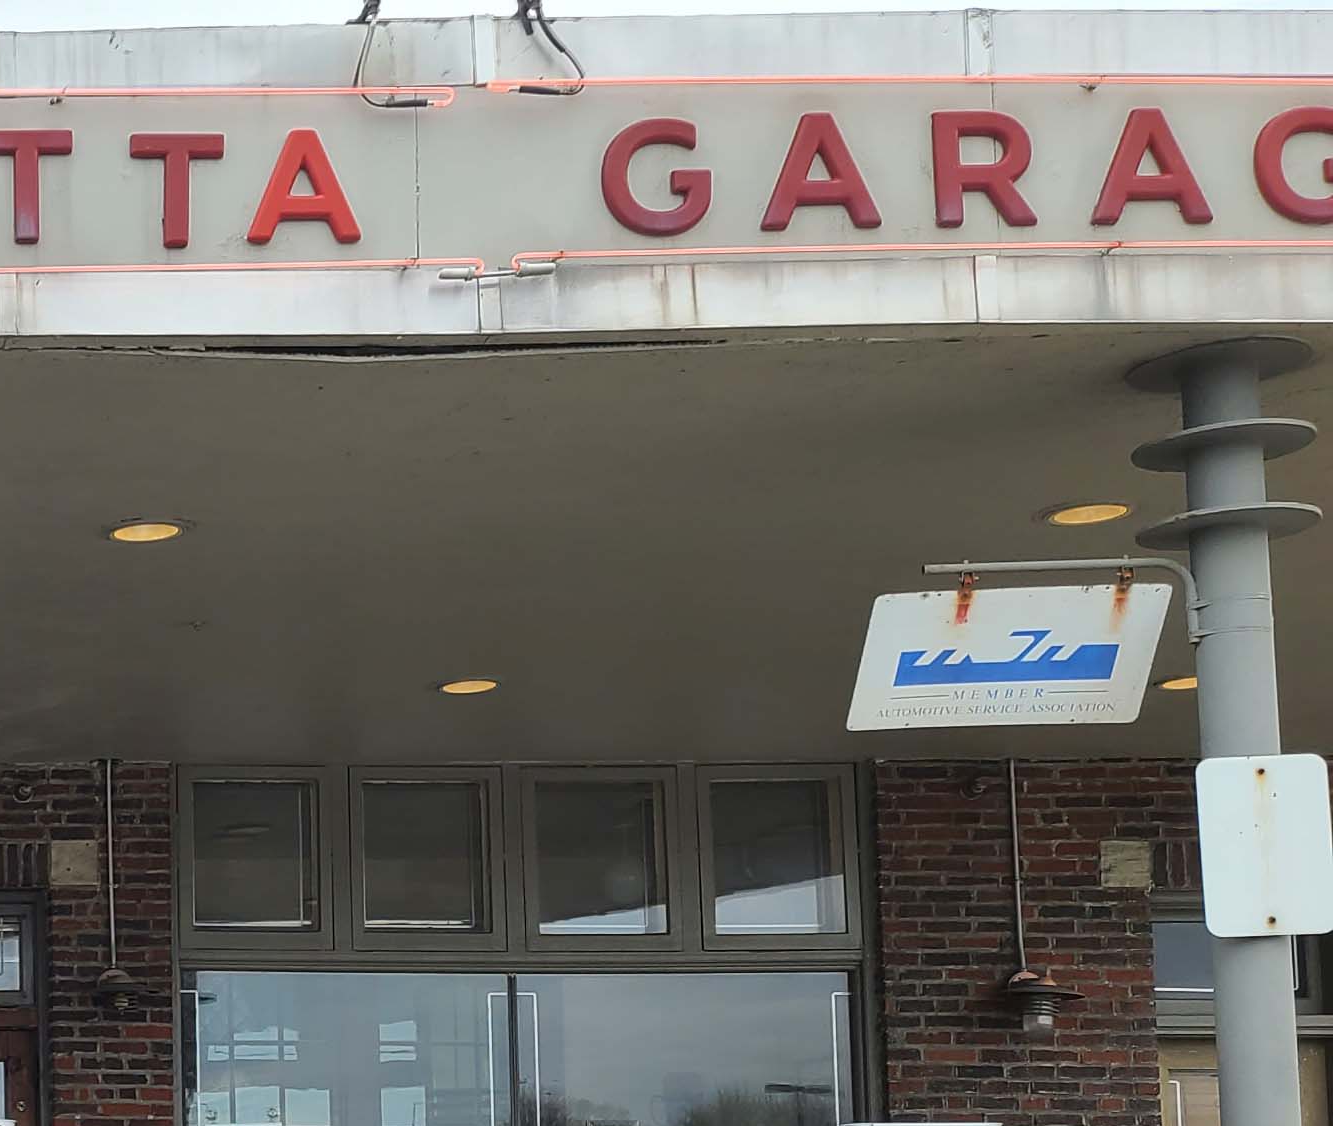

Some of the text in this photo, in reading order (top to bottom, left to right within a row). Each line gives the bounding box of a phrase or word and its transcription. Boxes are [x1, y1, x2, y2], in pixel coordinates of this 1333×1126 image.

[950, 688, 1046, 701] MEMBER
[876, 702, 1118, 718] AUTOMOTIVE SERVICE ASSOCIATION
